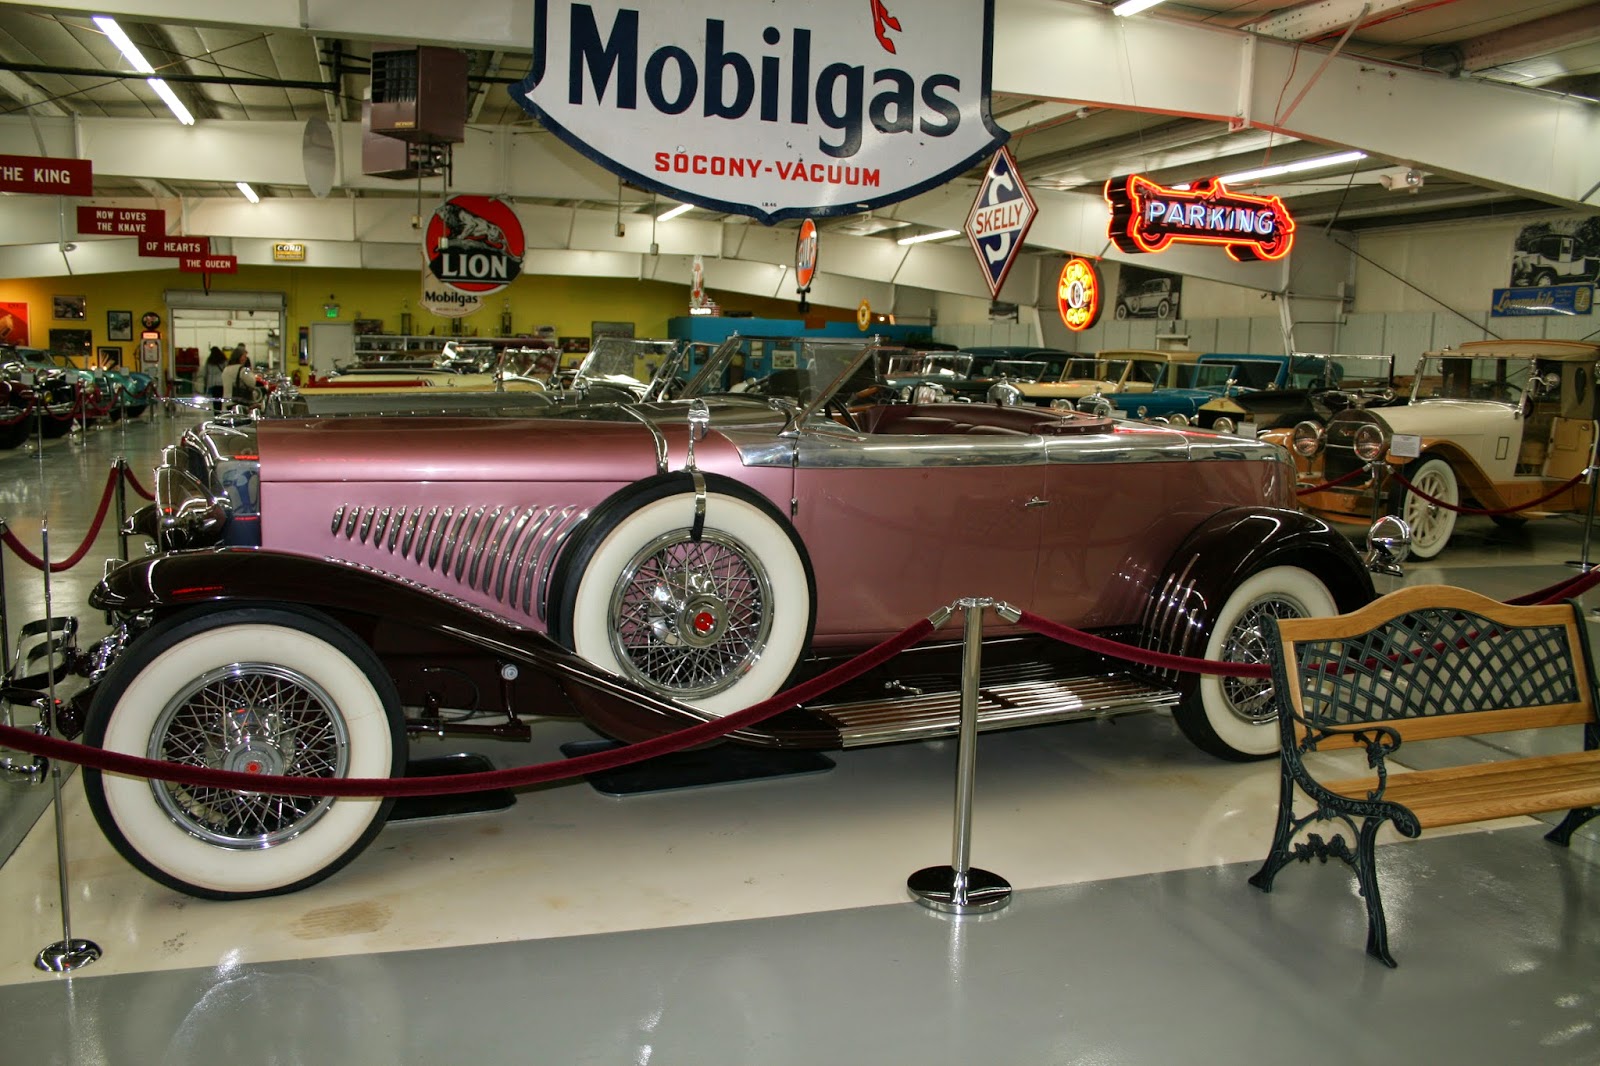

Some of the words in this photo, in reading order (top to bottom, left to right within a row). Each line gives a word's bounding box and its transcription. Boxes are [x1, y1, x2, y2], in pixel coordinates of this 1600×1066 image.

[569, 3, 961, 158] Mobilgas
[34, 168, 71, 184] KING
[655, 152, 880, 187] SOCONY-VACUUM
[96, 210, 114, 219] NOW
[120, 212, 147, 221] LOVES
[976, 202, 1024, 235] SKELLY
[1146, 201, 1274, 235] PARKING
[97, 222, 112, 231] THE
[118, 223, 146, 233] KNAVE
[146, 242, 158, 250] OF
[164, 243, 201, 252] HEARTS
[186, 259, 201, 267] THE
[205, 260, 231, 268] QUEEN
[441, 253, 507, 278] LION
[425, 291, 478, 307] Mobilgas
